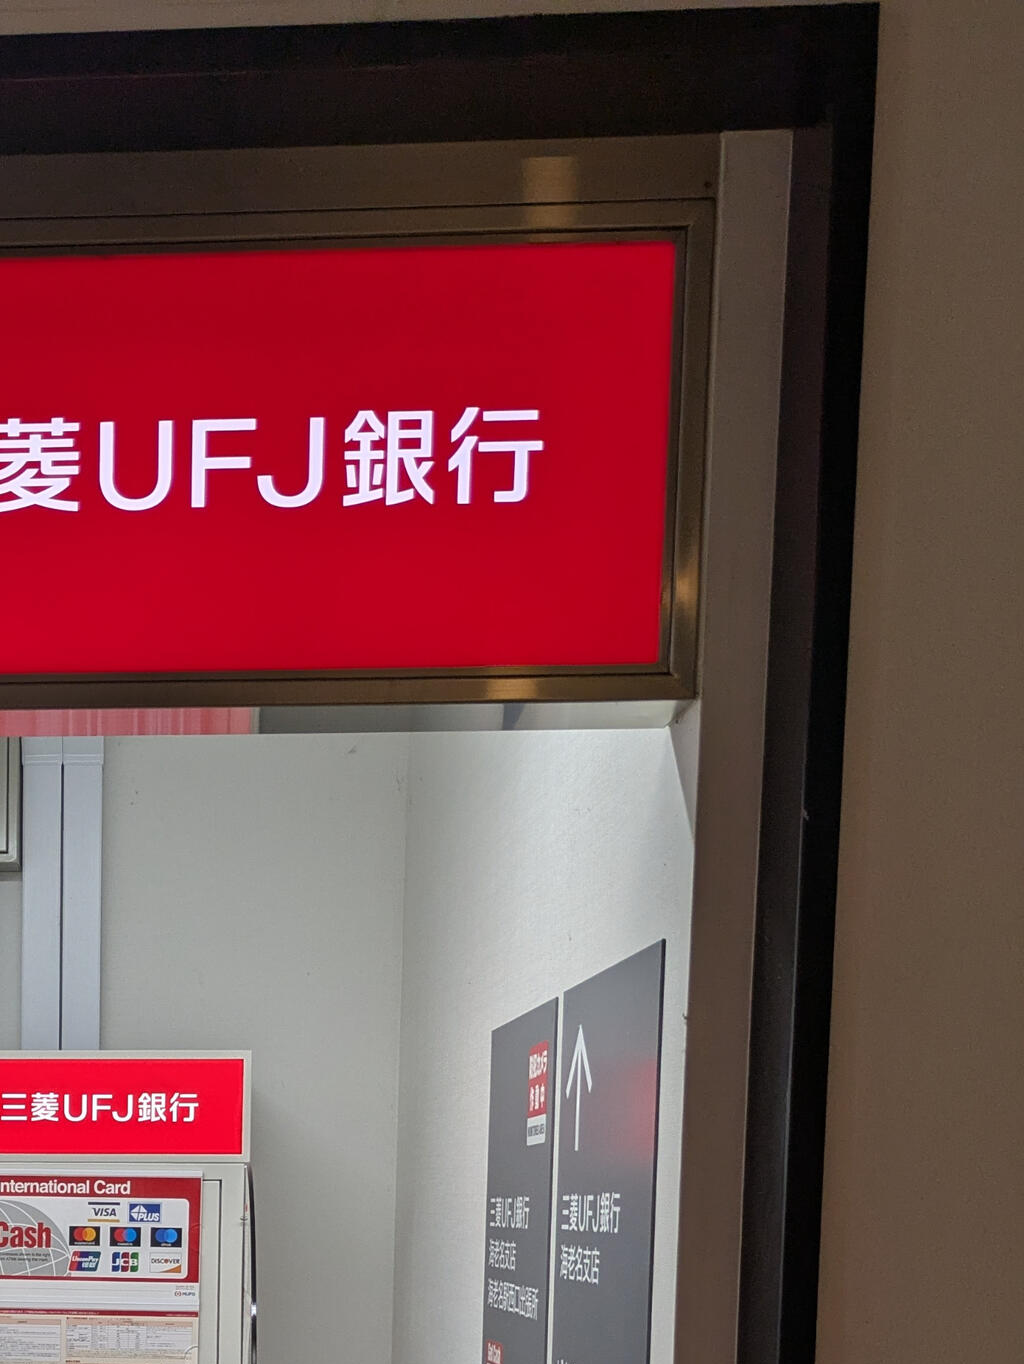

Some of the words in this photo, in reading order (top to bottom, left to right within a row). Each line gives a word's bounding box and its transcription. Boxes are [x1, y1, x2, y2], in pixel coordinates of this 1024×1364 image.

[0, 1091, 199, 1124] 三菱UFJ銀行
[93, 1180, 132, 1195] Card
[92, 1207, 117, 1217] VISA
[138, 1211, 161, 1222] PLUS
[489, 1196, 530, 1230] 三菱UFJ銀行
[561, 1191, 621, 1235] 三菱UFJ銀行
[111, 1257, 139, 1265] JCB
[488, 1238, 517, 1272] 海老名支店
[559, 1243, 600, 1285] 海老名支店
